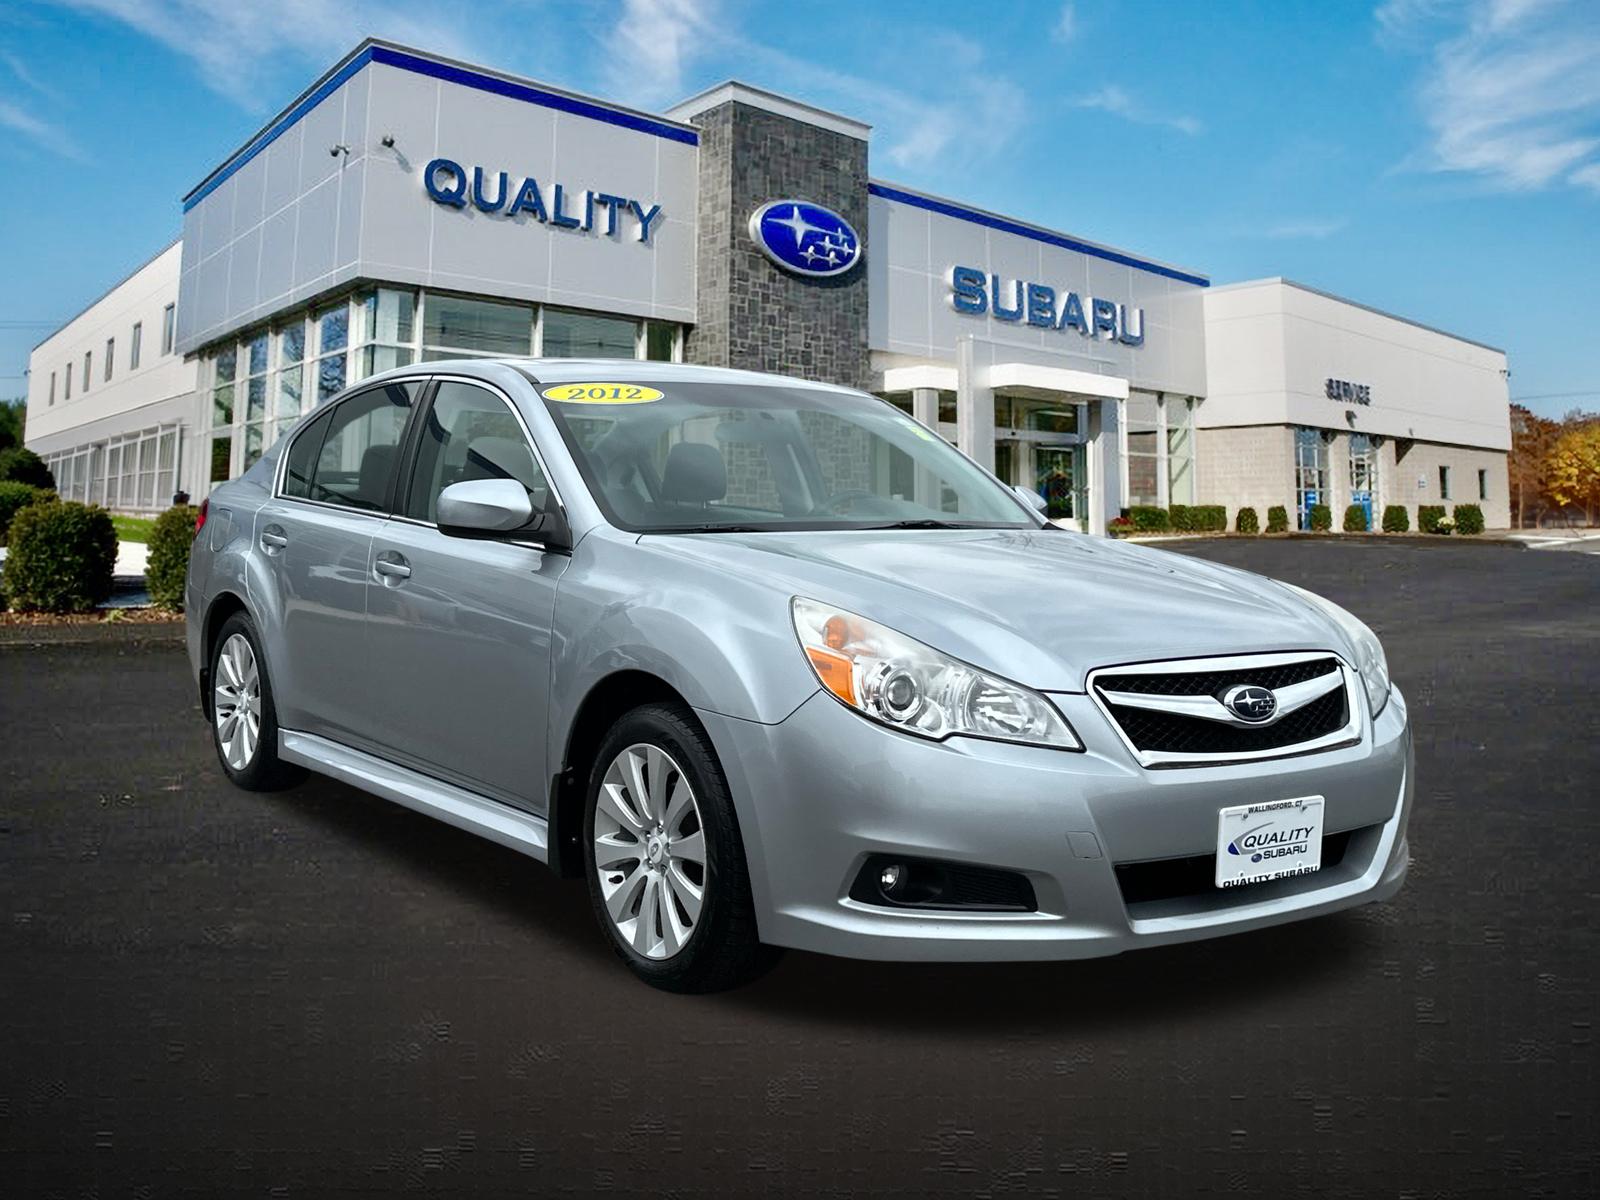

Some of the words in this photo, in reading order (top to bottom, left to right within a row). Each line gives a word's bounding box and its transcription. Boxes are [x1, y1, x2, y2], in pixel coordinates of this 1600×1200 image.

[424, 158, 662, 242] QUALITY
[952, 265, 1144, 346] SUBARU
[567, 387, 642, 400] 2012
[1244, 826, 1314, 848] QUALITY
[1263, 844, 1308, 860] SUBARU
[1223, 873, 1271, 888] QUALITY
[1275, 865, 1318, 880] SUBARU
